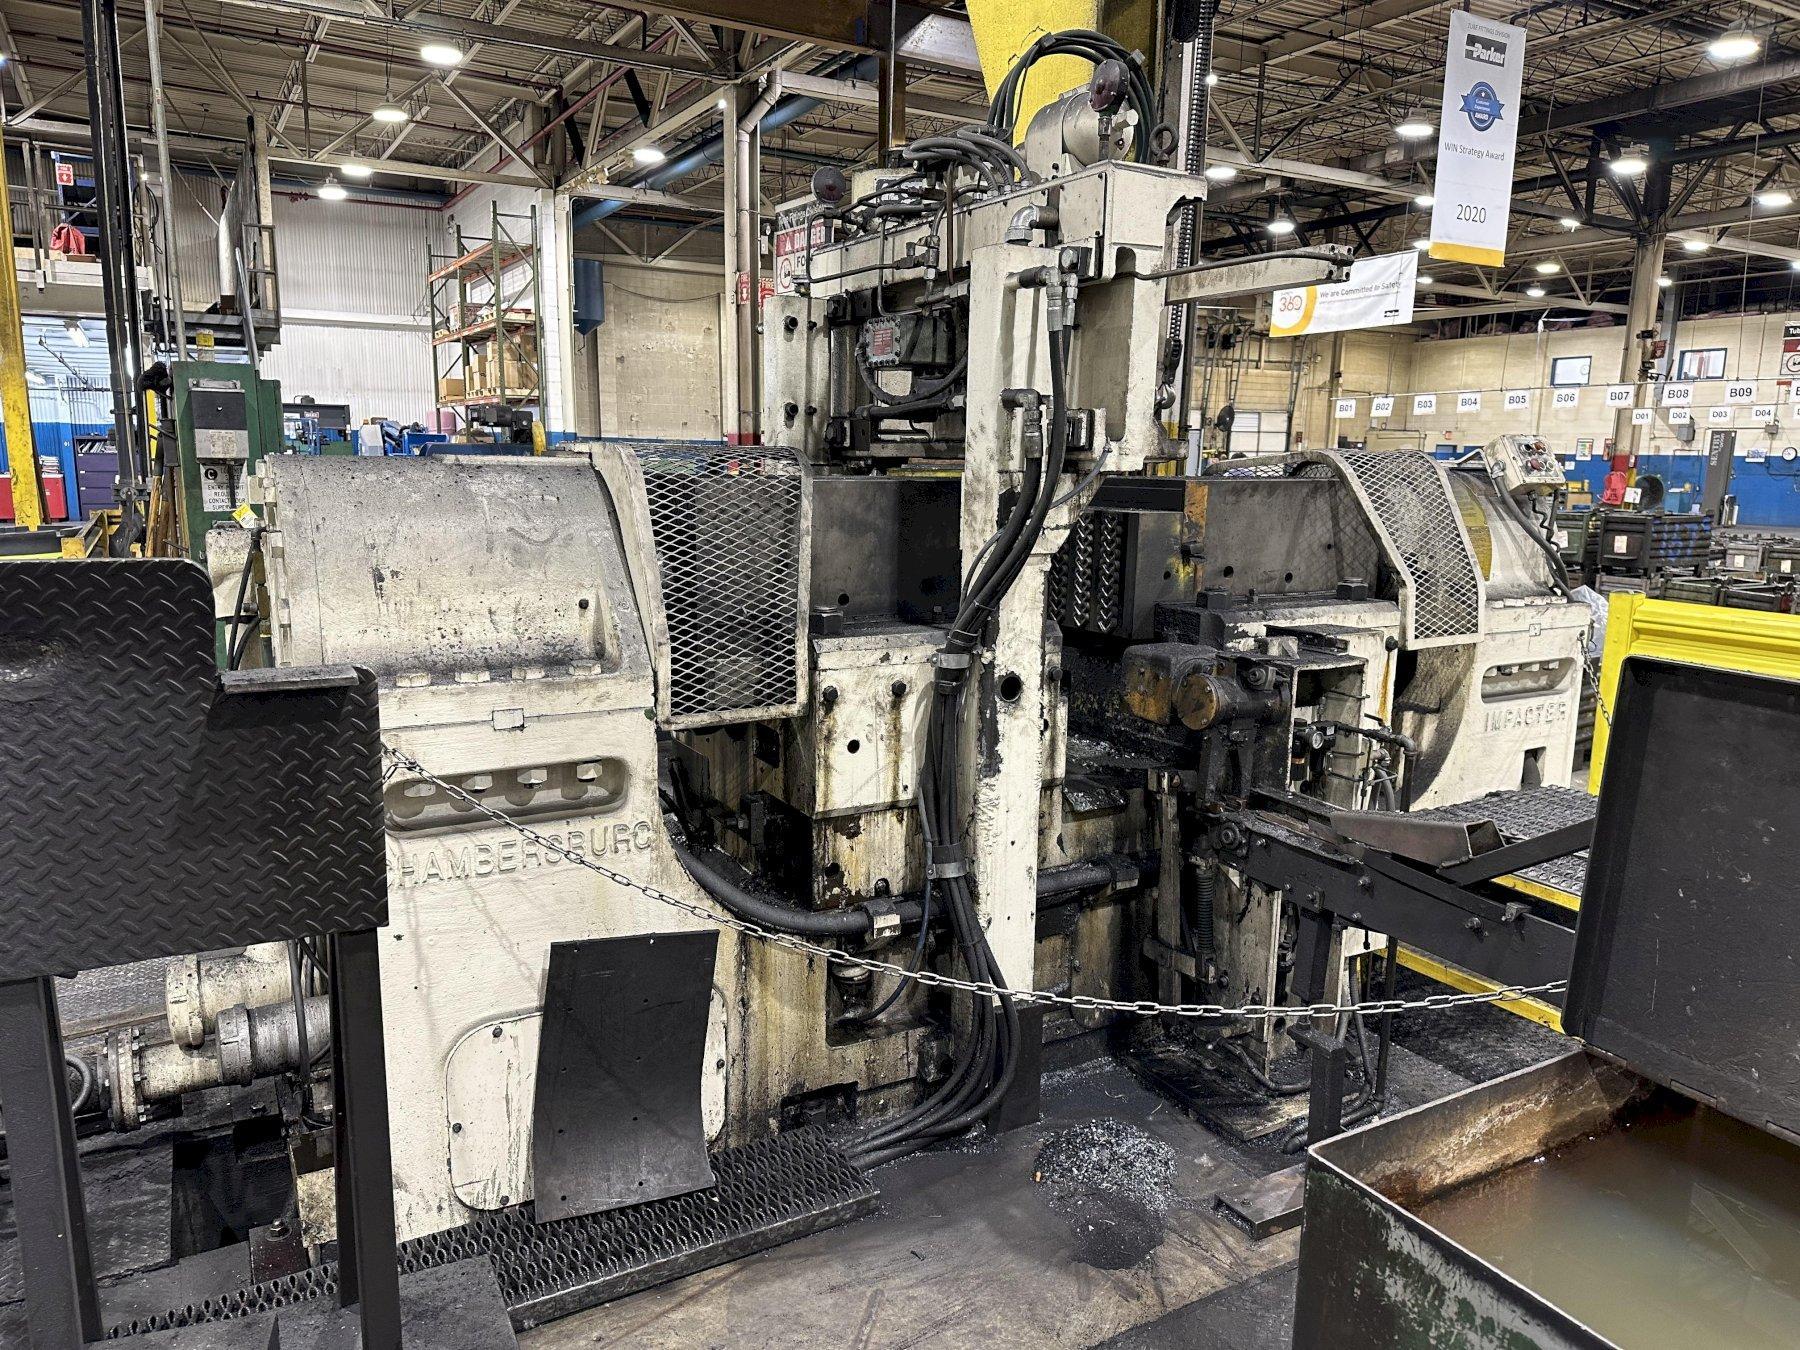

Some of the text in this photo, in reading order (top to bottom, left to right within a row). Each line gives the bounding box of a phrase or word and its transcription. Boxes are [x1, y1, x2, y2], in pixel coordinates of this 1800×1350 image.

[1472, 42, 1505, 64] Parker
[1444, 142, 1504, 161] WIN Strategy Award
[1456, 203, 1486, 224] 2020
[1330, 289, 1339, 297] are
[1341, 284, 1373, 296] Committed
[1381, 280, 1401, 291] Safety
[1280, 295, 1303, 312] 360
[1610, 391, 1630, 401] B07
[1667, 388, 1689, 399] B08
[1729, 387, 1753, 398] B09
[1461, 397, 1478, 407] B04
[1508, 395, 1526, 404] B05
[1339, 404, 1353, 412] B01
[1375, 403, 1390, 411] B02
[1417, 401, 1433, 409] B03
[1635, 412, 1649, 420] D01
[1672, 411, 1687, 419] D02
[1712, 410, 1728, 418] D03
[1755, 409, 1771, 417] D04
[1485, 702, 1566, 731] IMPACTER
